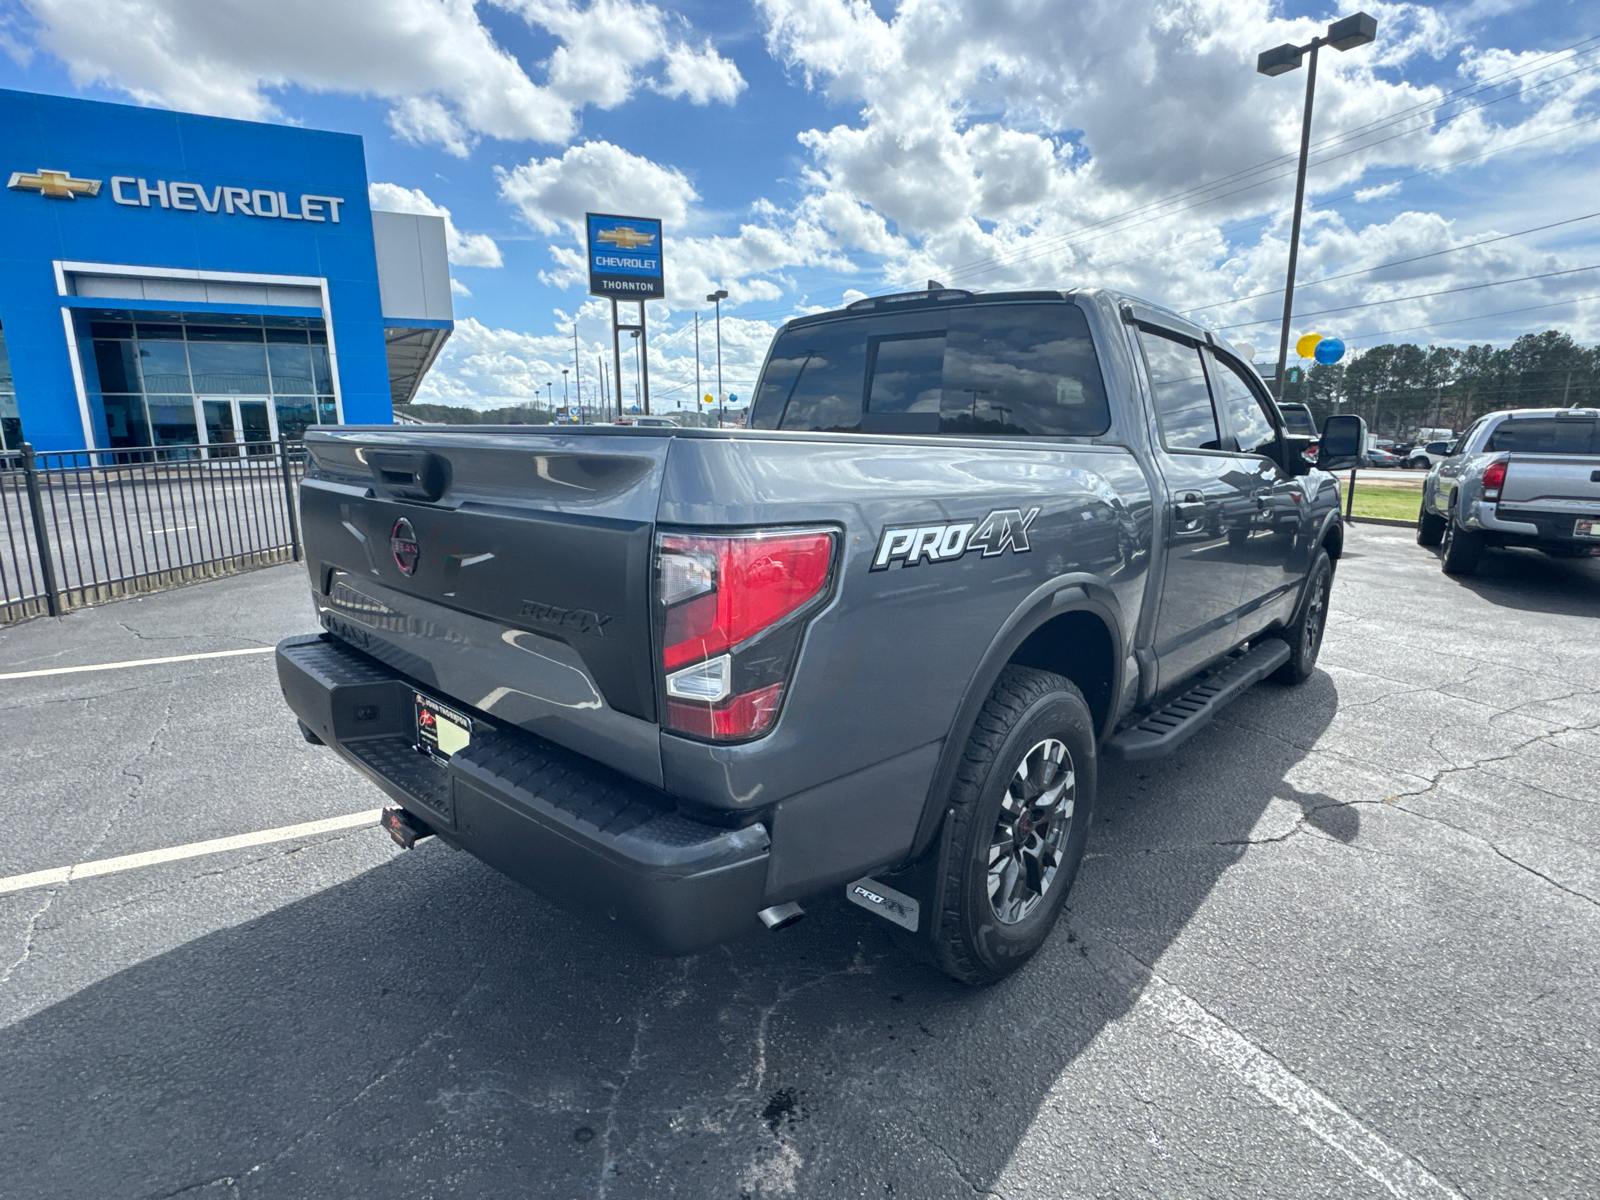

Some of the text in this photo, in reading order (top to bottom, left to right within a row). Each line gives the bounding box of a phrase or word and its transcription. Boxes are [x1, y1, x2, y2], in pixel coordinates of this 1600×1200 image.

[110, 176, 345, 223] CHEVROLET
[595, 256, 657, 269] CHEVROLET
[602, 280, 654, 291] THORNTON
